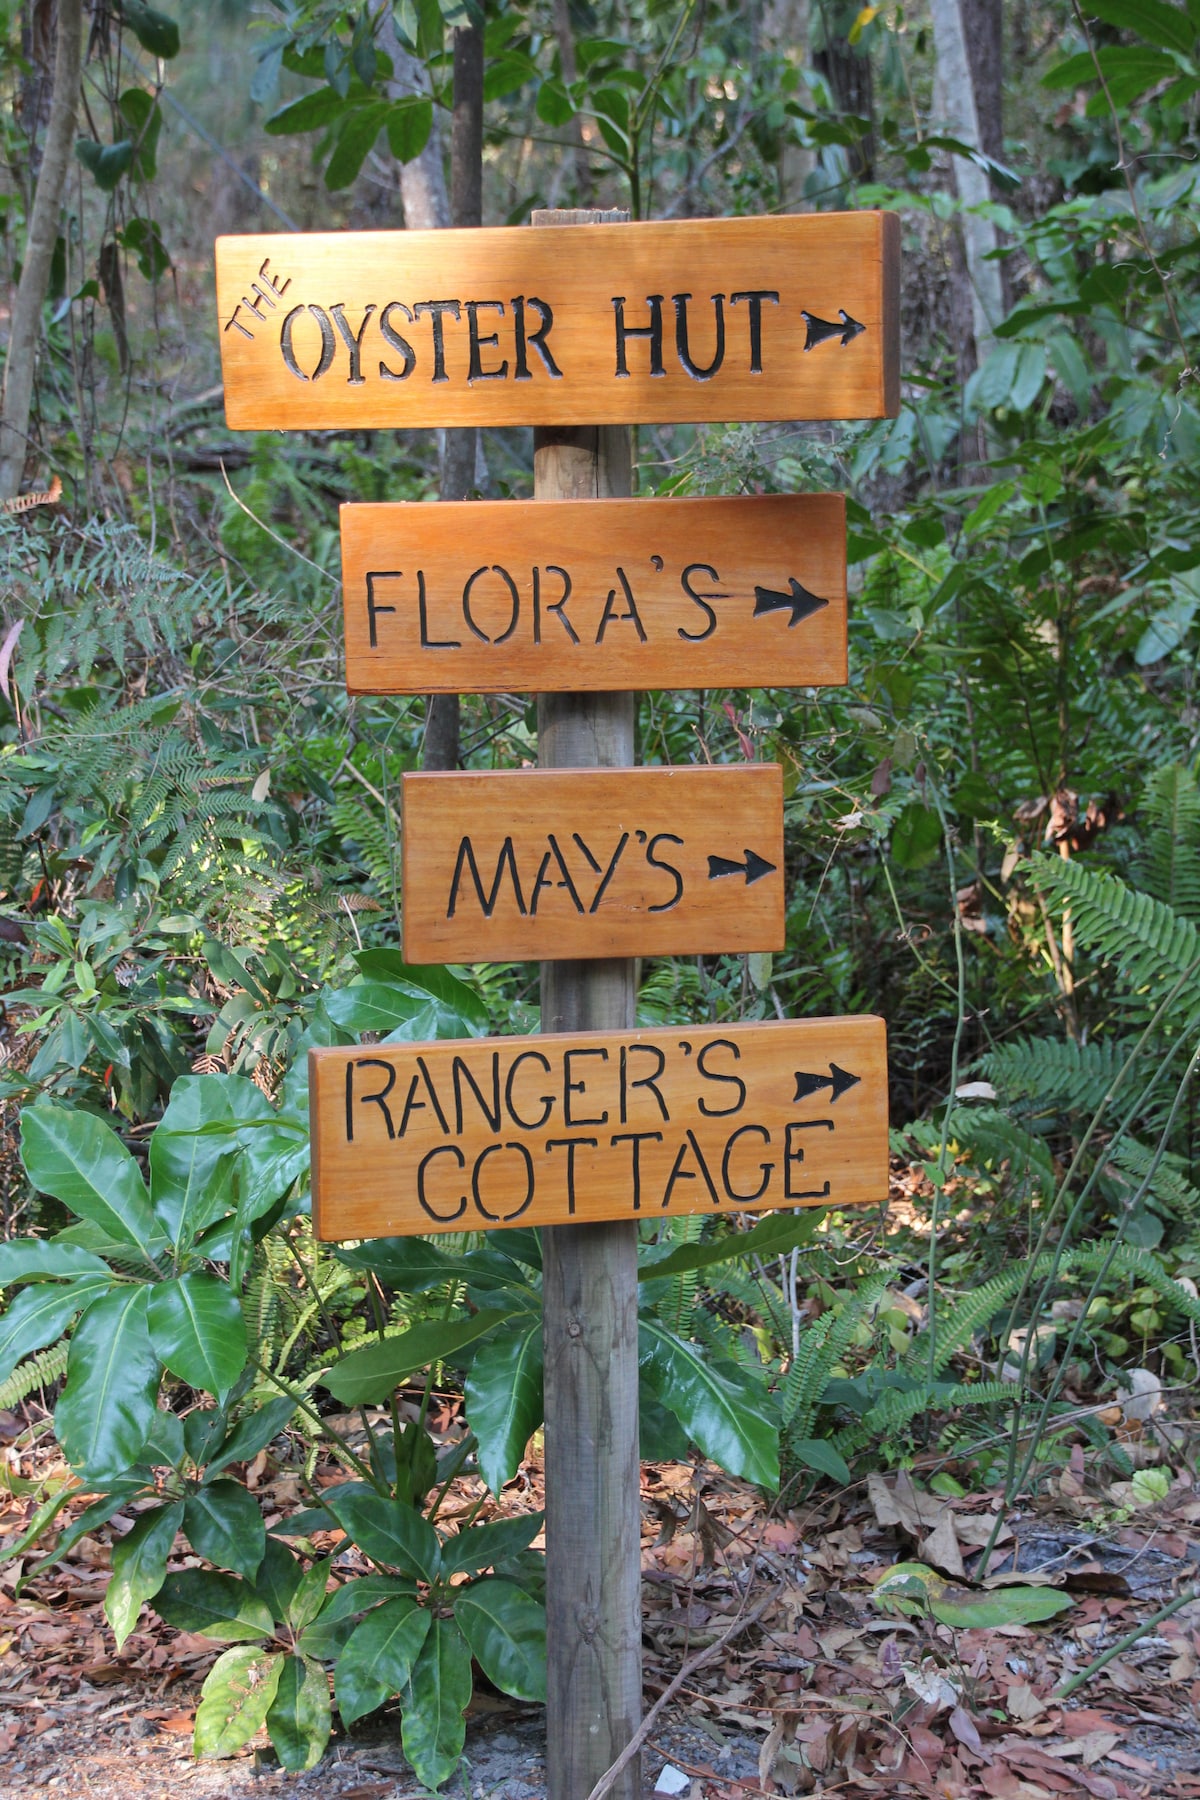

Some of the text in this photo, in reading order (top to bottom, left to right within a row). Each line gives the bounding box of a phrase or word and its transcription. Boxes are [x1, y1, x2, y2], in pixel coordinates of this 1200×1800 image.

[224, 257, 292, 341] THE
[280, 290, 779, 386] OYSTER HUT
[366, 555, 720, 648] FLORA'S
[447, 830, 684, 918] MAY'S
[346, 1040, 747, 1143] RANGER'S
[418, 1119, 835, 1224] COTTAGE
